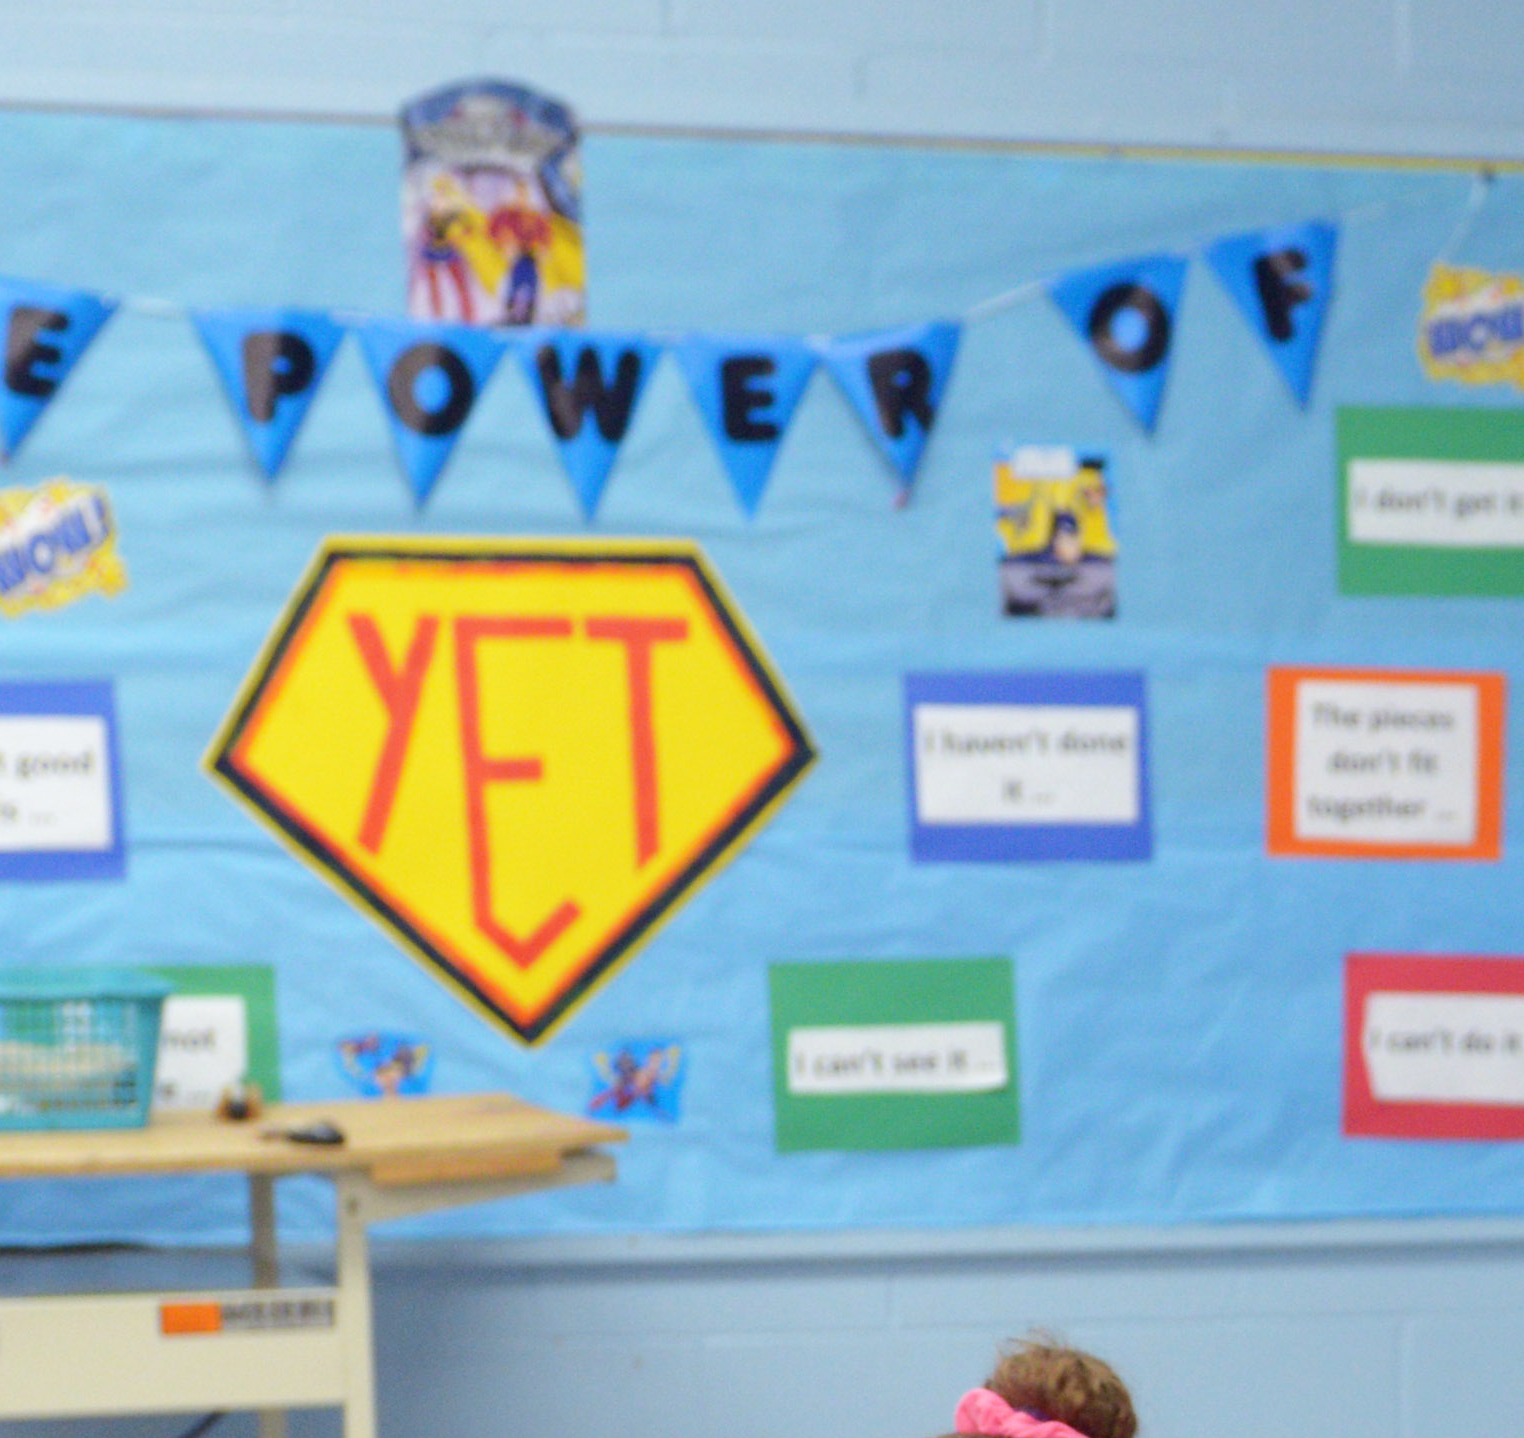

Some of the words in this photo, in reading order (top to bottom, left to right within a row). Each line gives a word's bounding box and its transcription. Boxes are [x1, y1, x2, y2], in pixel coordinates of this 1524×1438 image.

[240, 329, 934, 444] POWER
[1087, 247, 1314, 373] OF
[1377, 485, 1448, 512] don't
[1454, 491, 1498, 520] get
[1312, 702, 1359, 728] The
[1367, 705, 1454, 733] pieces
[942, 726, 1050, 754] haven't
[1057, 727, 1128, 753] done
[17, 749, 96, 781] good
[1328, 751, 1401, 775] don't
[344, 612, 689, 970] YET
[1387, 1029, 1455, 1054] can't
[813, 1050, 884, 1075] can't
